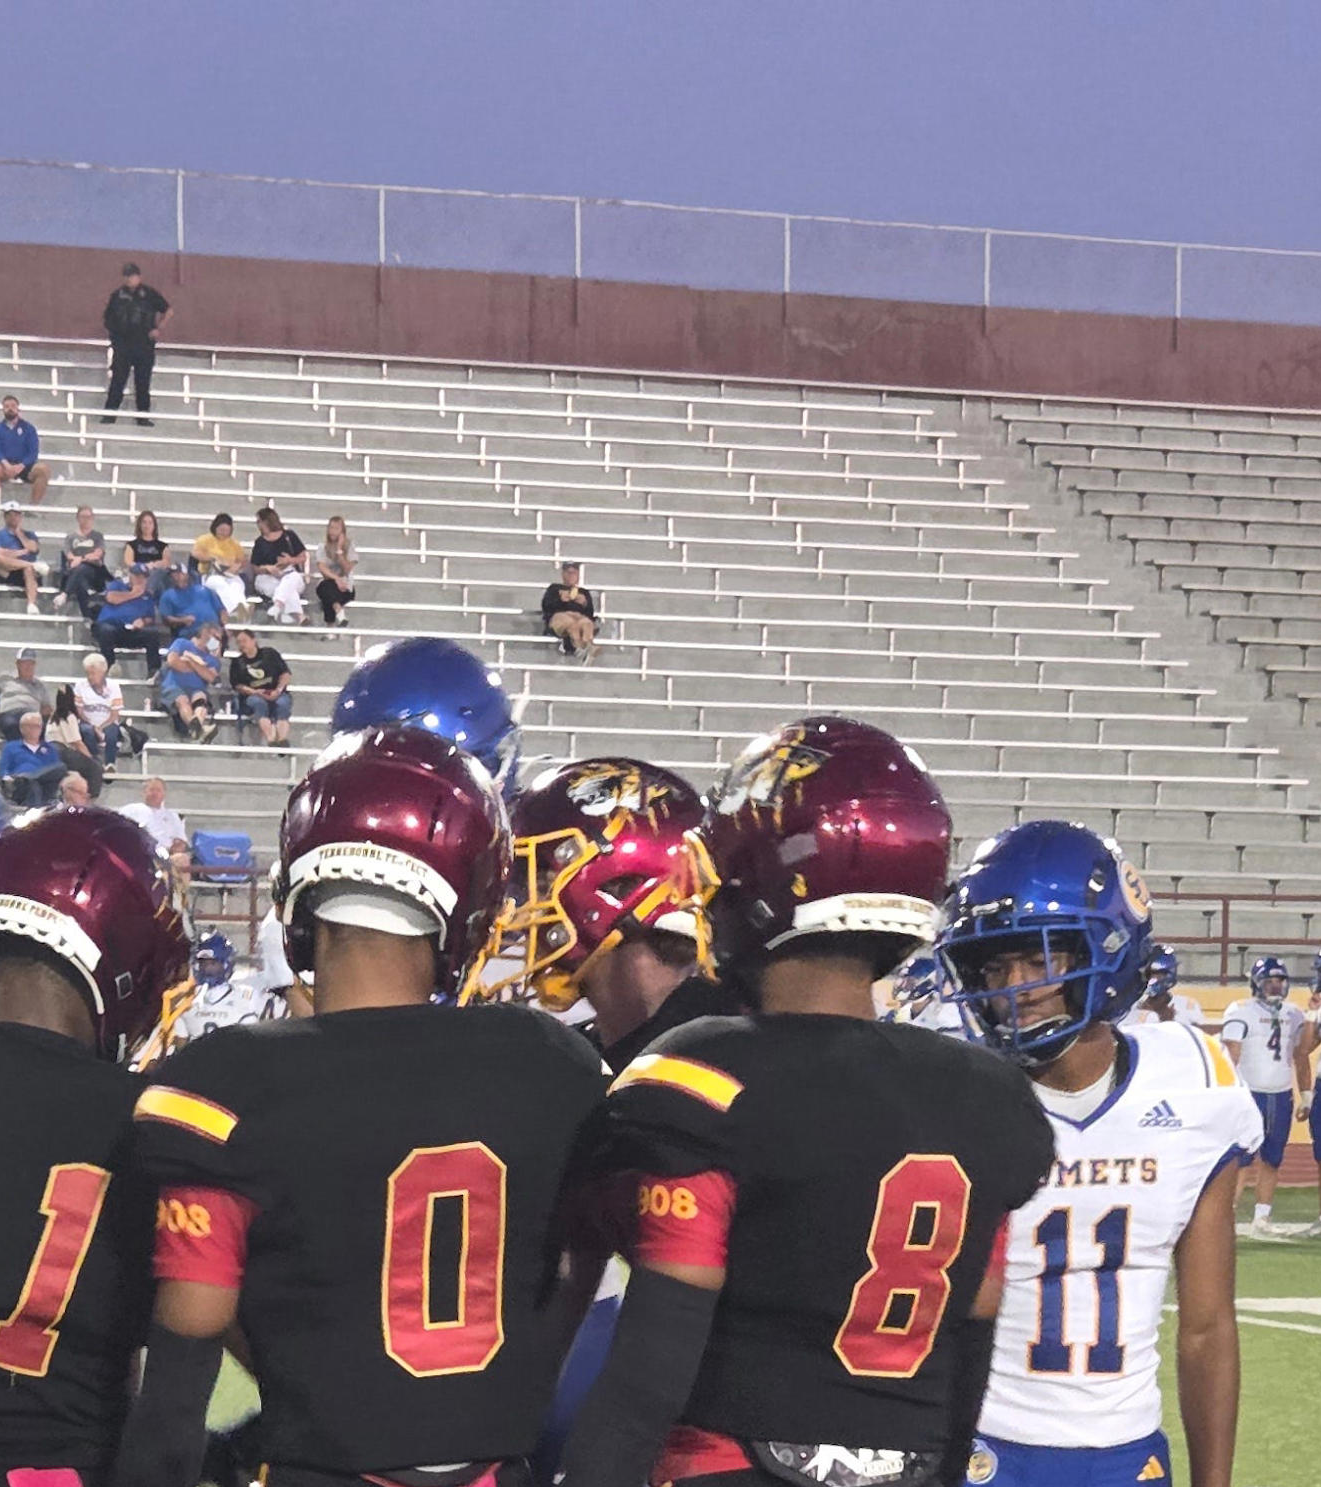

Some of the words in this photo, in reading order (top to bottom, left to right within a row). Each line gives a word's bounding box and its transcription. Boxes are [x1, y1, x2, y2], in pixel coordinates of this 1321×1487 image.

[1267, 1026, 1282, 1061] 4
[1039, 1156, 1159, 1188] METS
[381, 1140, 508, 1378] 0
[833, 1153, 972, 1378] 8
[1026, 1205, 1131, 1375] 11
